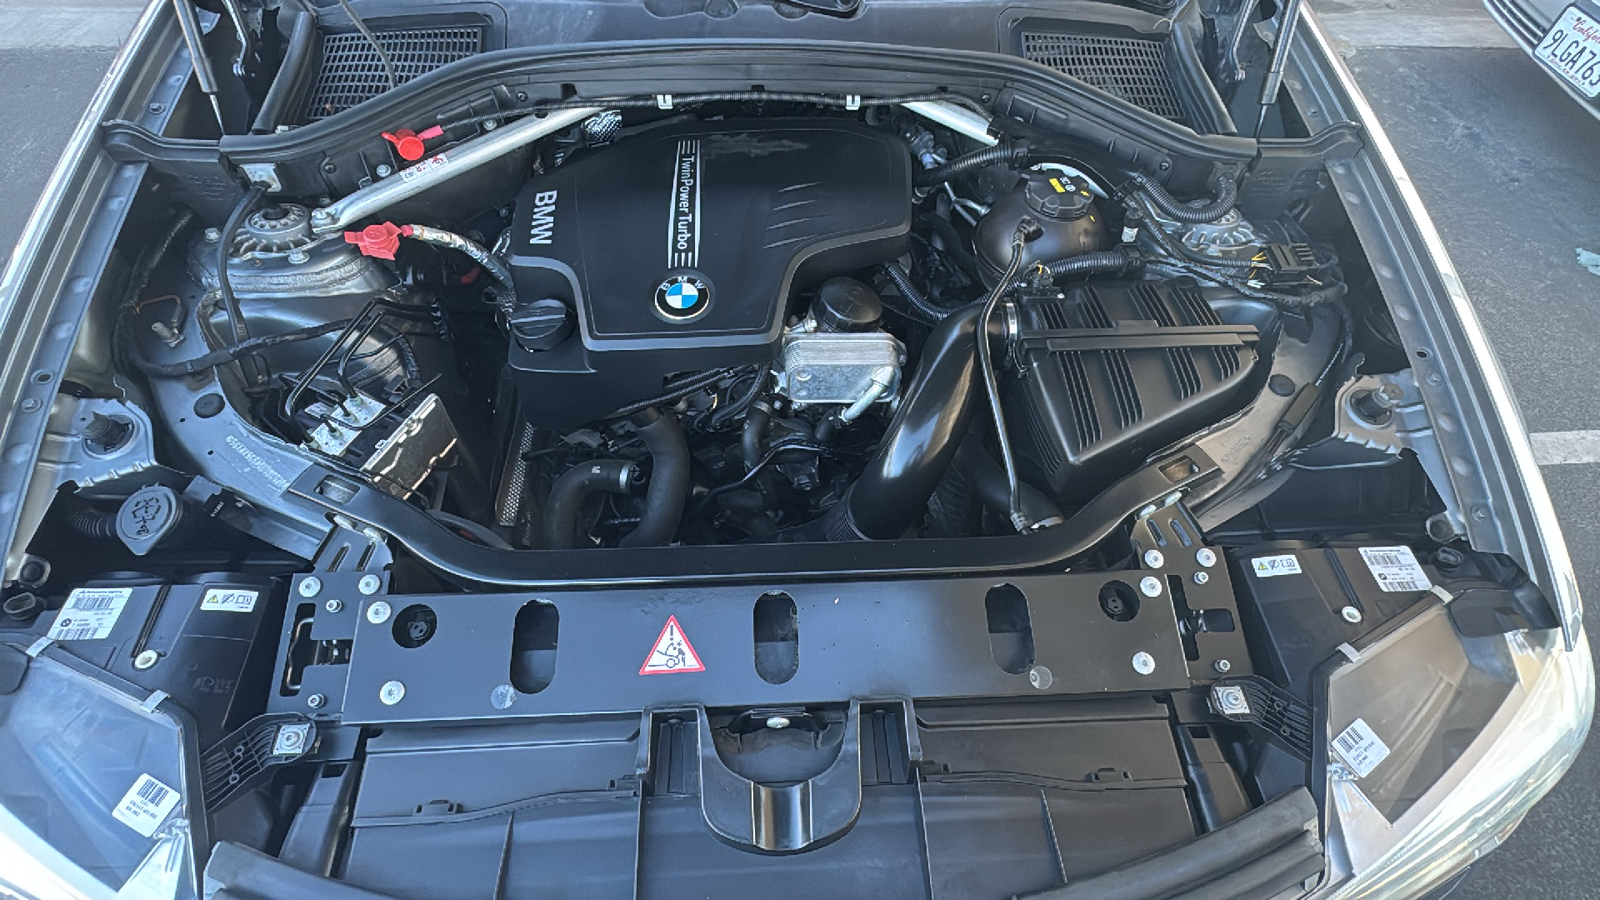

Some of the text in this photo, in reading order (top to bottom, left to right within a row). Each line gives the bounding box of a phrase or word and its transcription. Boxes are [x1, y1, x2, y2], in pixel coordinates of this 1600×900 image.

[530, 190, 557, 244] BMW
[677, 155, 695, 250] TwinPower Turbo
[660, 276, 705, 291] BMW
